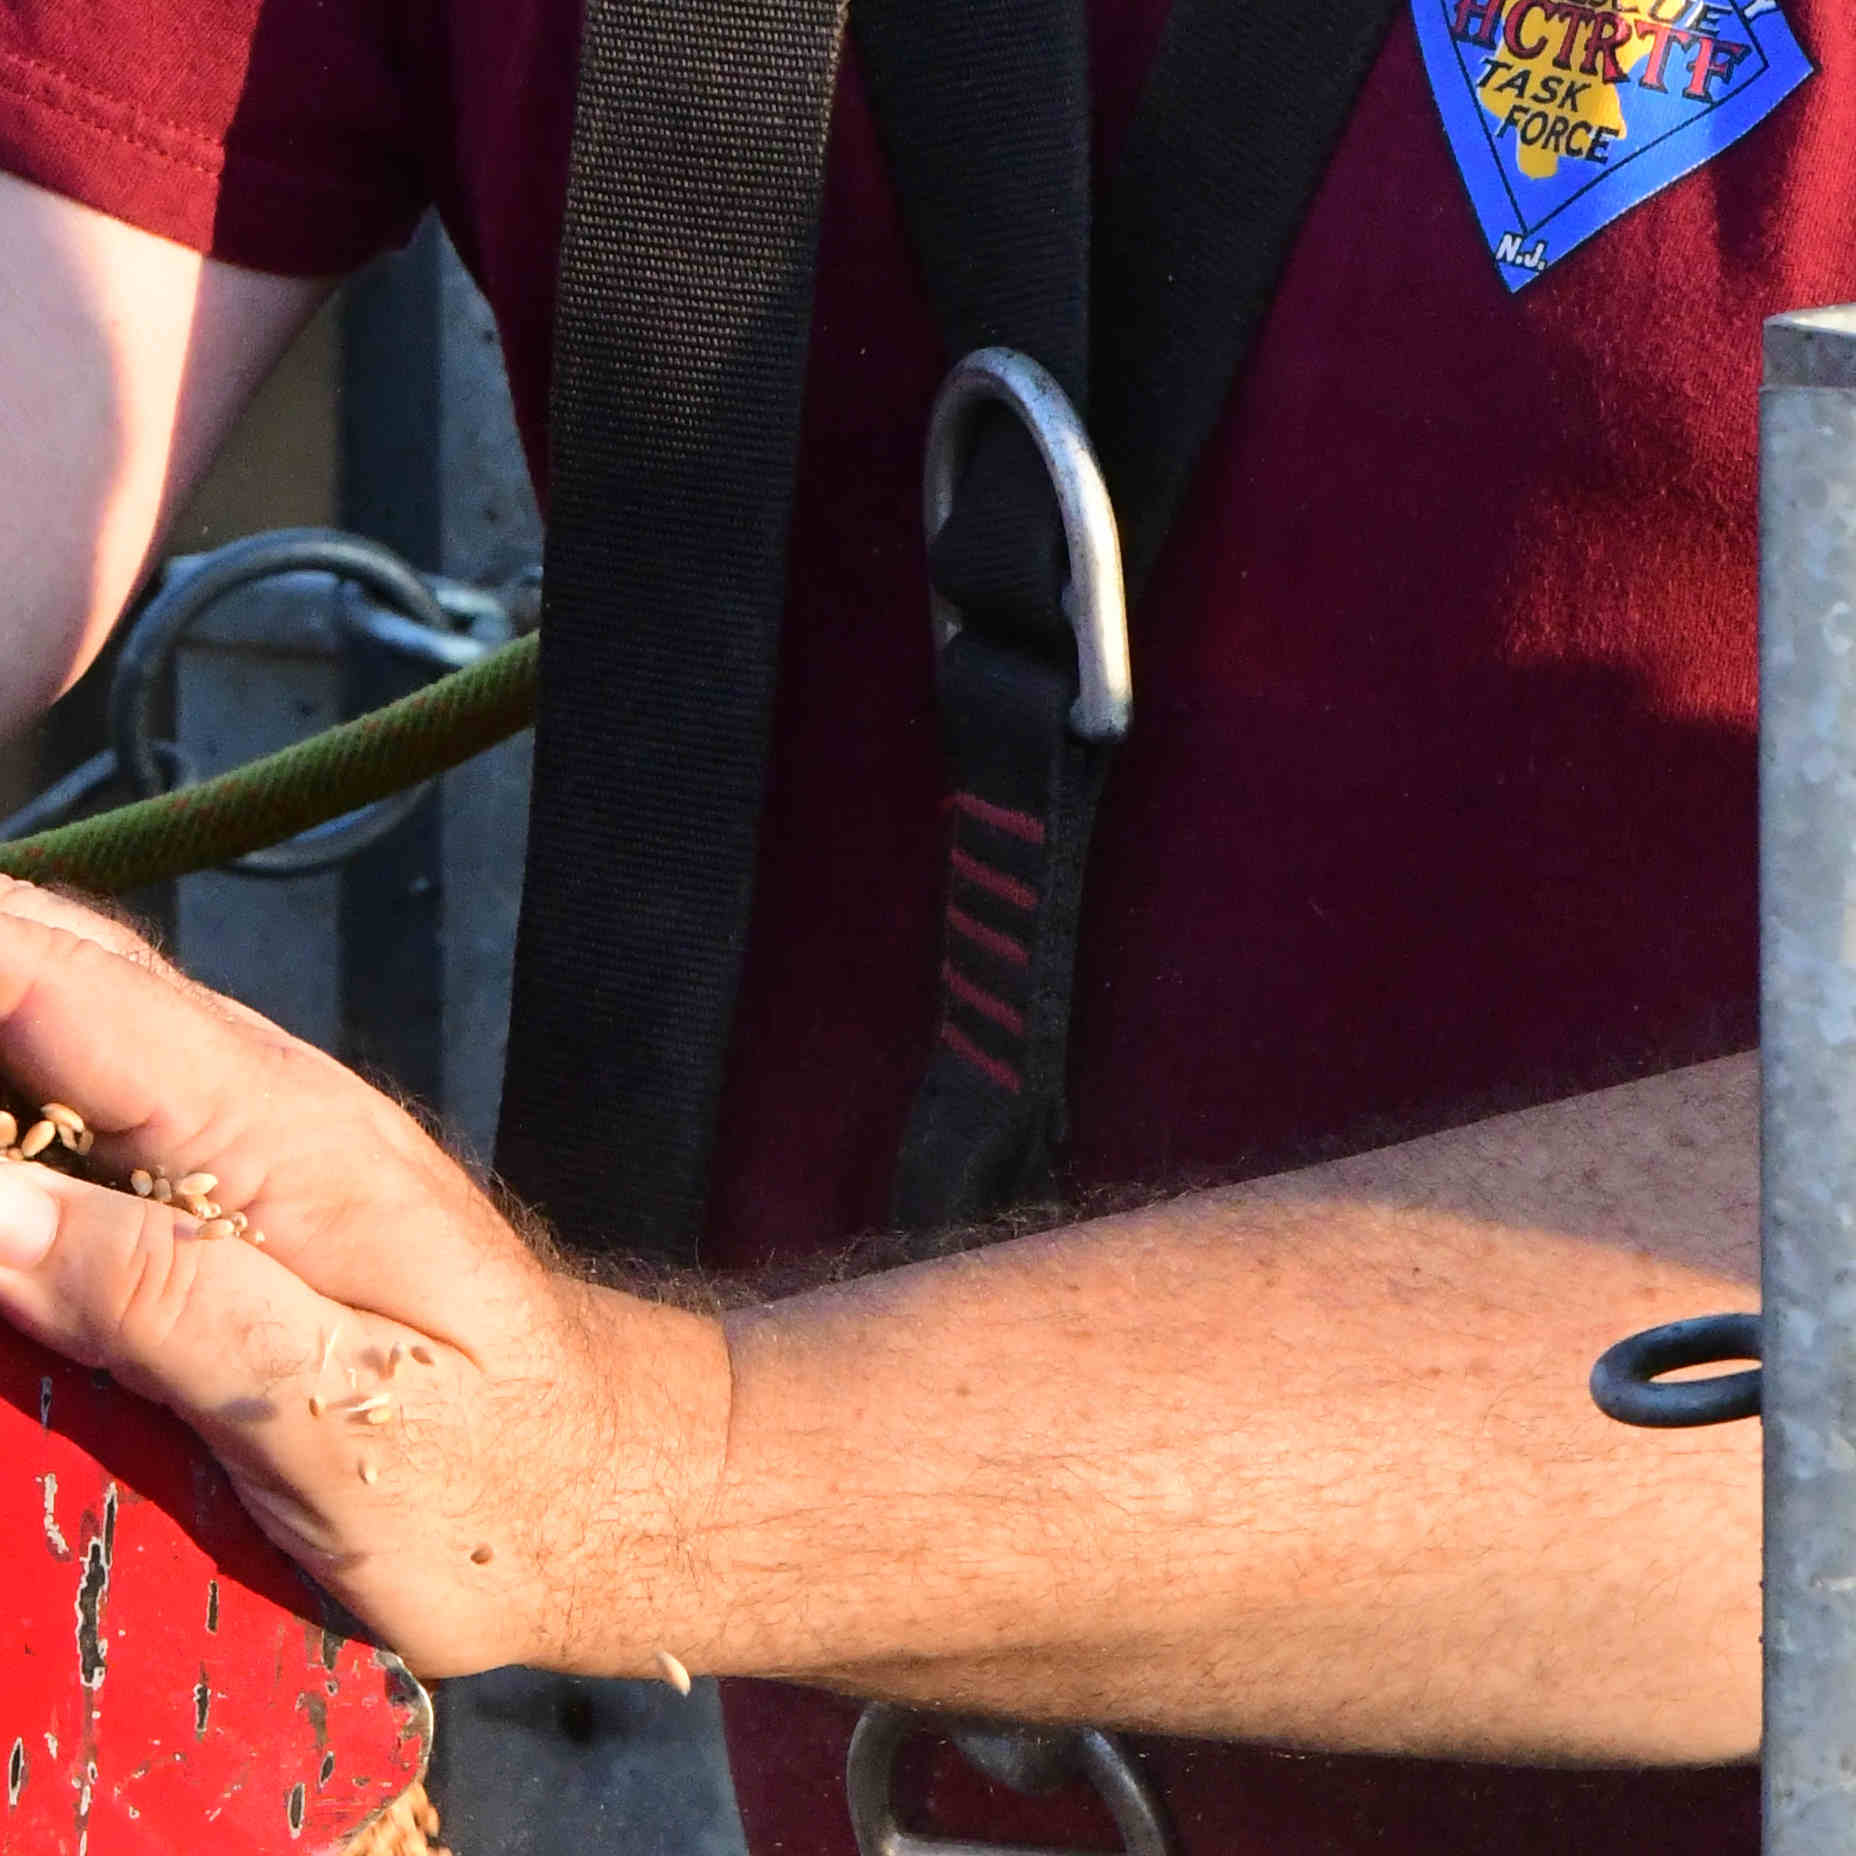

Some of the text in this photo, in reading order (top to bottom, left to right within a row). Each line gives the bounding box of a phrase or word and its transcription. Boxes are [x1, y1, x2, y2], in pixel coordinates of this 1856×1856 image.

[1476, 57, 1592, 113] TASK
[1496, 103, 1621, 164] FORCE
[1496, 232, 1548, 273] N.J.
